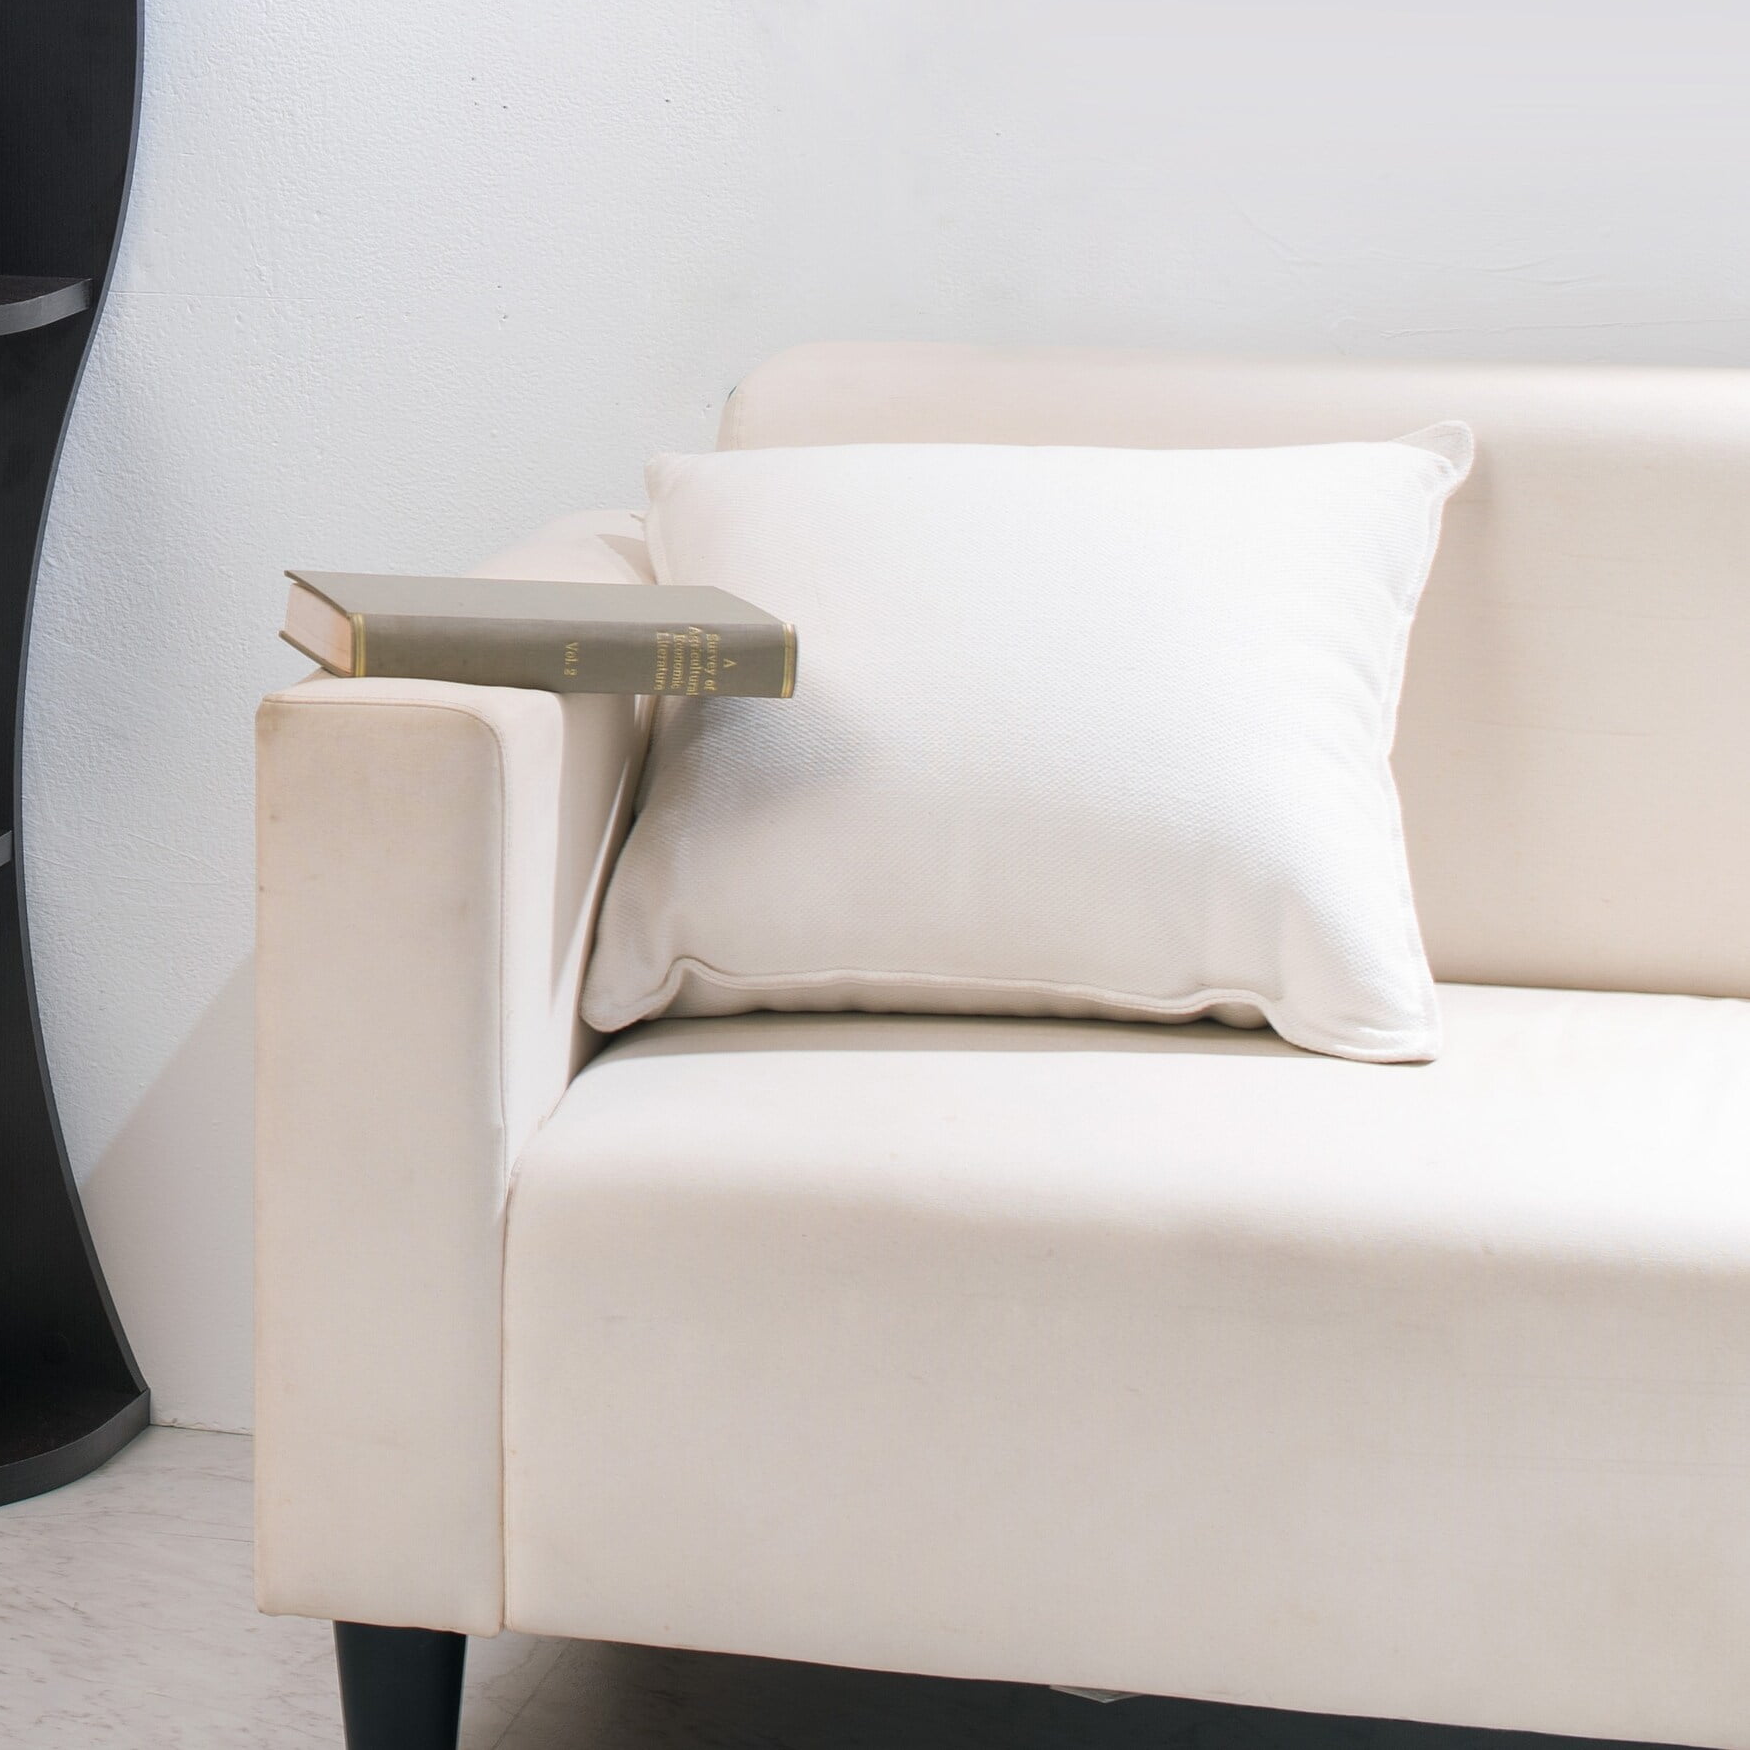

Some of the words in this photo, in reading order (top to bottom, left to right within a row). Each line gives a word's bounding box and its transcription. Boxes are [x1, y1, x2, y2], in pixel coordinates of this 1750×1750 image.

[565, 642, 579, 665] Vol.
[686, 626, 701, 696] Agricultural
[705, 633, 721, 673] Survey
[723, 659, 736, 668] A
[704, 679, 716, 692] of
